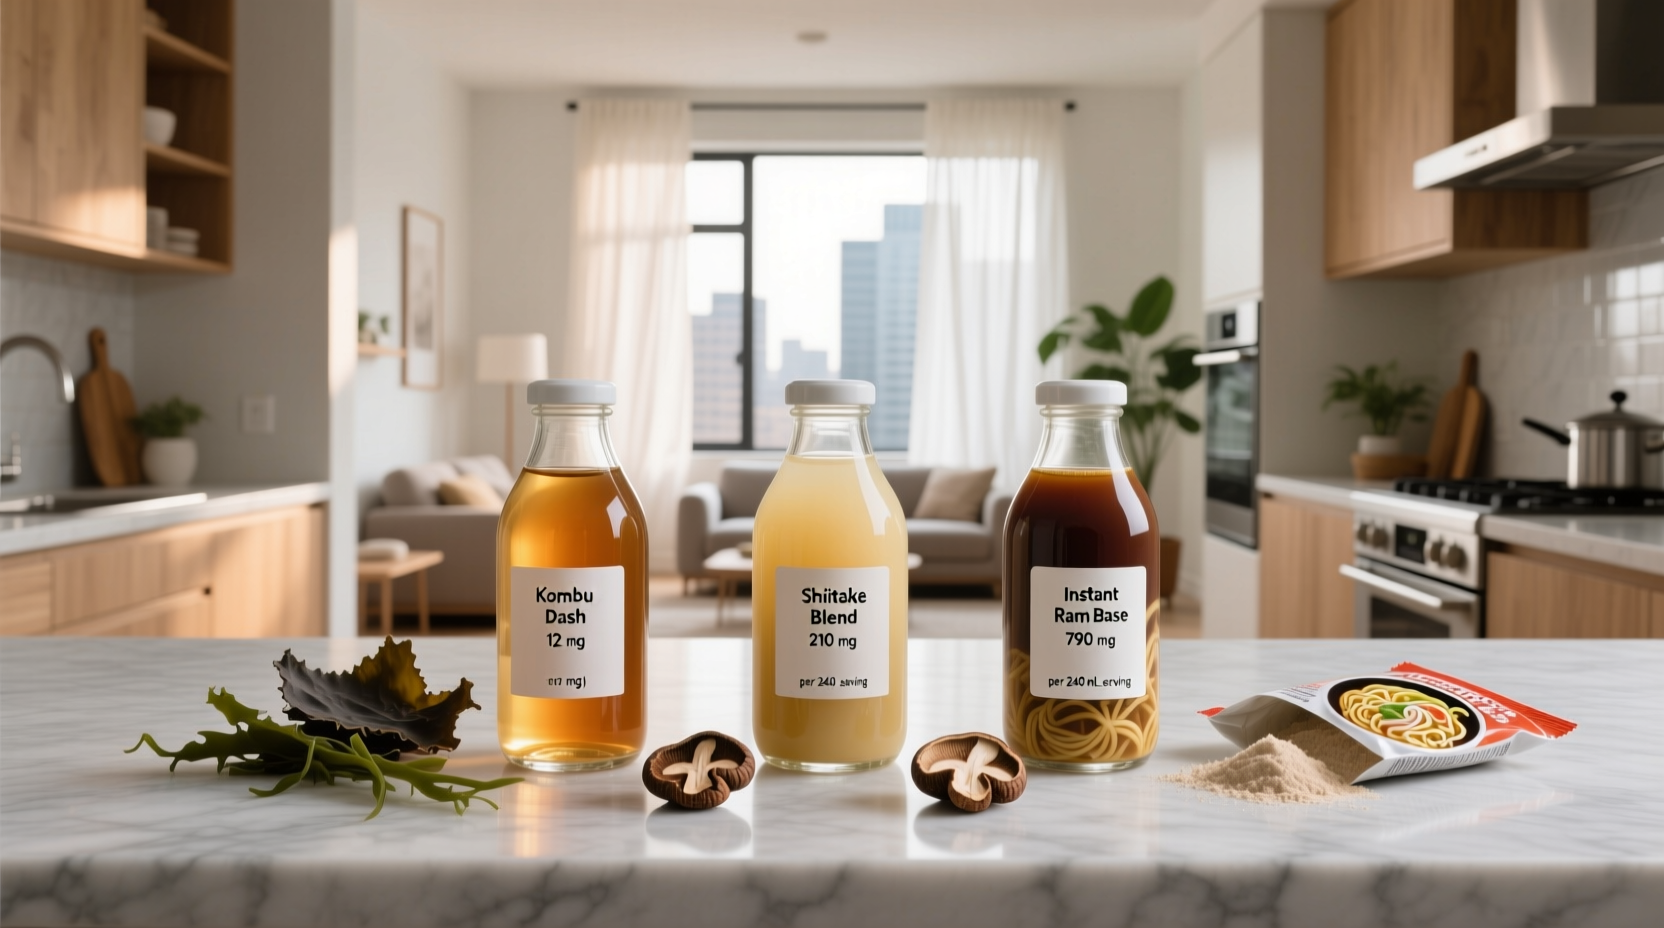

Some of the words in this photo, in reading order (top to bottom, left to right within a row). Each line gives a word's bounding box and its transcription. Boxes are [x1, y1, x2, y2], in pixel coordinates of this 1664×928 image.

[536, 586, 594, 603] Kombu
[801, 587, 867, 604] Shiitake
[1064, 586, 1119, 602] Instant
[545, 608, 586, 624] Dash
[811, 609, 858, 625] Blend
[1054, 607, 1091, 623] Ram
[1093, 607, 1129, 623] Base
[546, 632, 563, 648] 12
[566, 637, 586, 651] mg
[809, 632, 834, 647] 210
[838, 637, 857, 650] mg
[1065, 632, 1094, 646] 790
[1097, 636, 1116, 649] mg
[799, 678, 815, 689] per
[1048, 677, 1065, 688] per
[1066, 676, 1086, 687] 240
